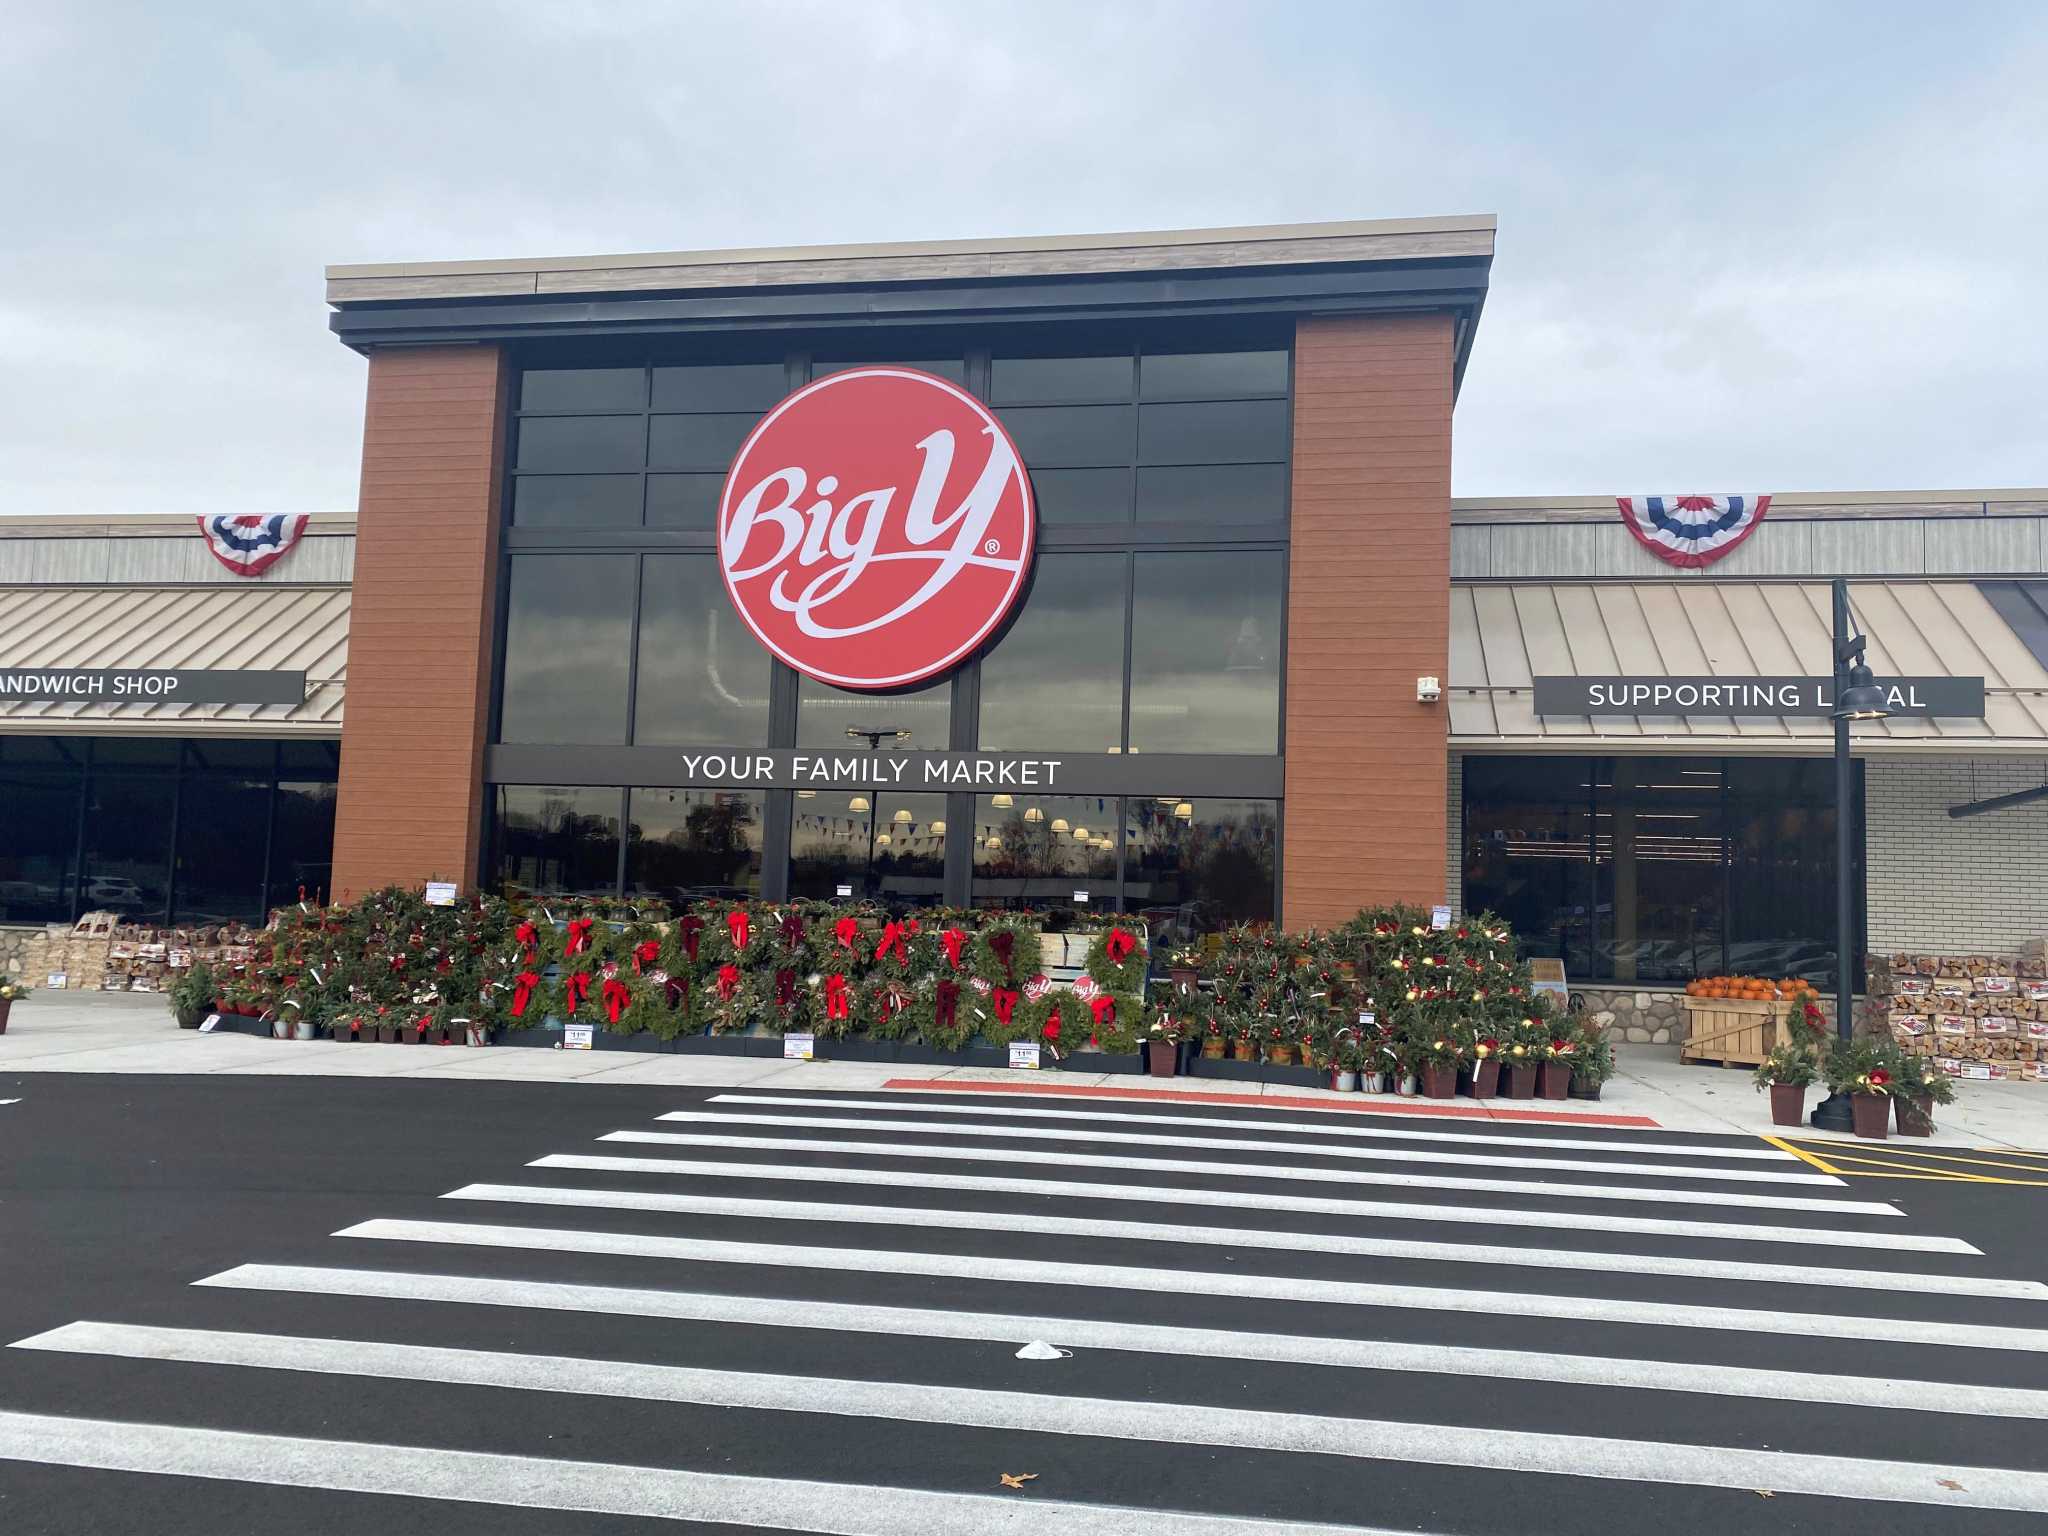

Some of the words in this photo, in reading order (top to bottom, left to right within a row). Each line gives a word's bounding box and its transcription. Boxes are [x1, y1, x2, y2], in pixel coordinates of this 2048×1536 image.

[724, 466, 897, 612] Big
[112, 676, 178, 695] SHOP
[1588, 684, 1800, 707] SUPPORTING
[1817, 685, 1927, 707] LAL
[682, 755, 774, 780] YOUR
[792, 757, 909, 782] FAMILY
[924, 759, 1062, 785] MARKET
